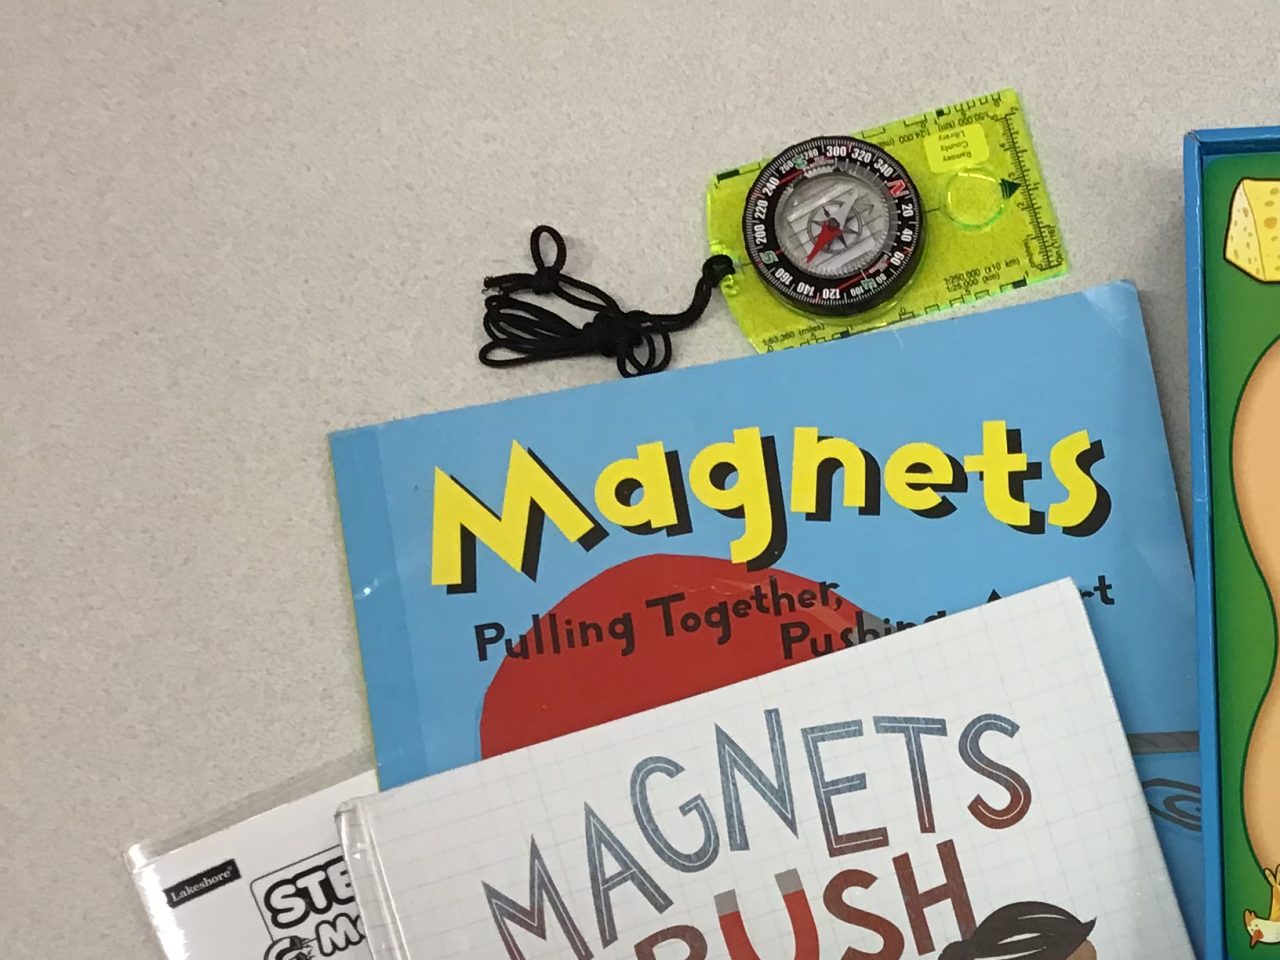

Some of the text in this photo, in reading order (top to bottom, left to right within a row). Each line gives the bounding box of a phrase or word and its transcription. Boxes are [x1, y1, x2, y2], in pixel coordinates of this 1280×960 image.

[826, 146, 848, 158] 300
[851, 148, 873, 164] 320
[873, 158, 894, 177] 340
[762, 176, 780, 196] 240
[887, 179, 910, 198] N
[754, 200, 768, 220] 220
[901, 203, 914, 218] 20
[754, 224, 768, 245] 200
[901, 228, 914, 242] 40
[759, 250, 779, 265] S
[890, 251, 905, 267] 60
[774, 267, 794, 286] 160
[796, 281, 816, 297] 140
[822, 288, 841, 300] 120
[430, 419, 1112, 594] Magnets
[473, 574, 844, 663] Pulling Together,
[780, 610, 947, 660] Pushi
